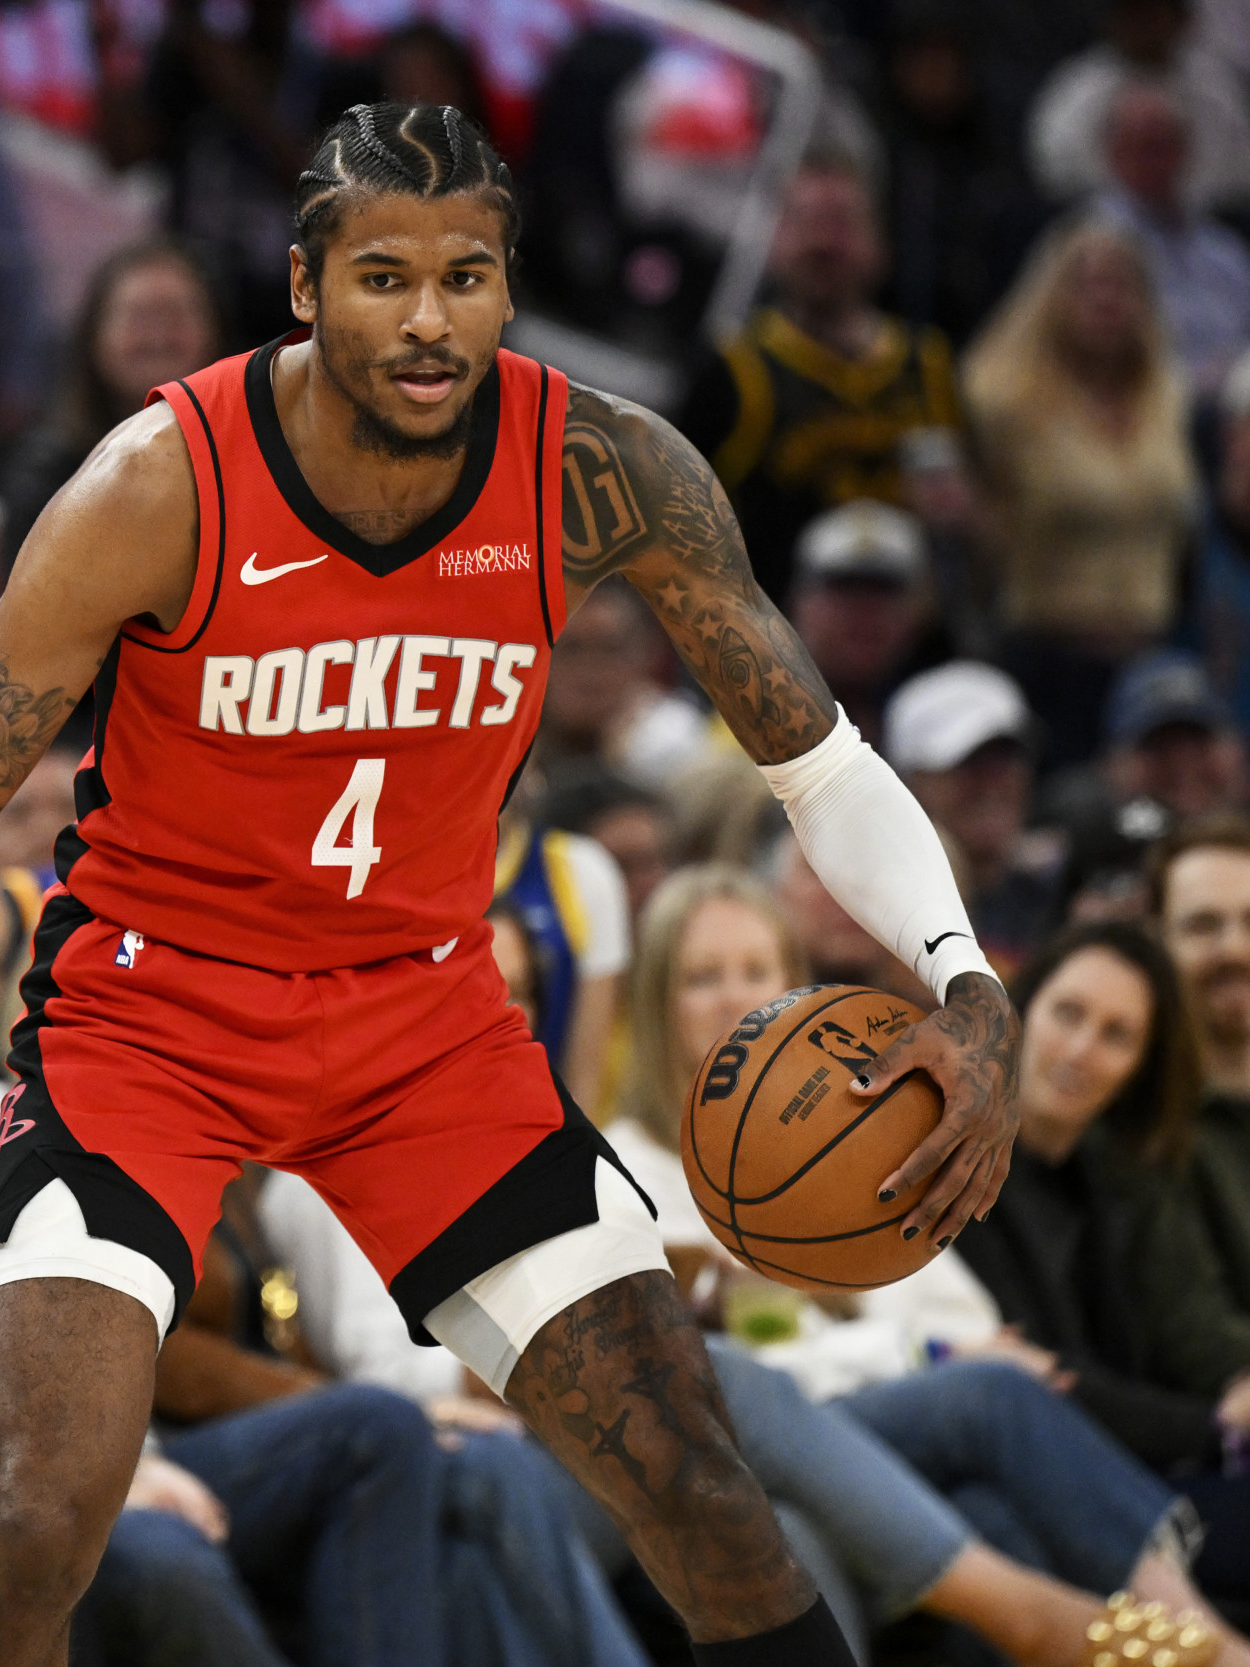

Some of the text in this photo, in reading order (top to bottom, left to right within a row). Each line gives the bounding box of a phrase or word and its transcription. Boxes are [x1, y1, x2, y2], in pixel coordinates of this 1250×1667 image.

[439, 543, 531, 565] MEMORIAL
[439, 555, 530, 577] HERMANN
[198, 634, 537, 736] ROCKETS
[311, 758, 386, 900] 4
